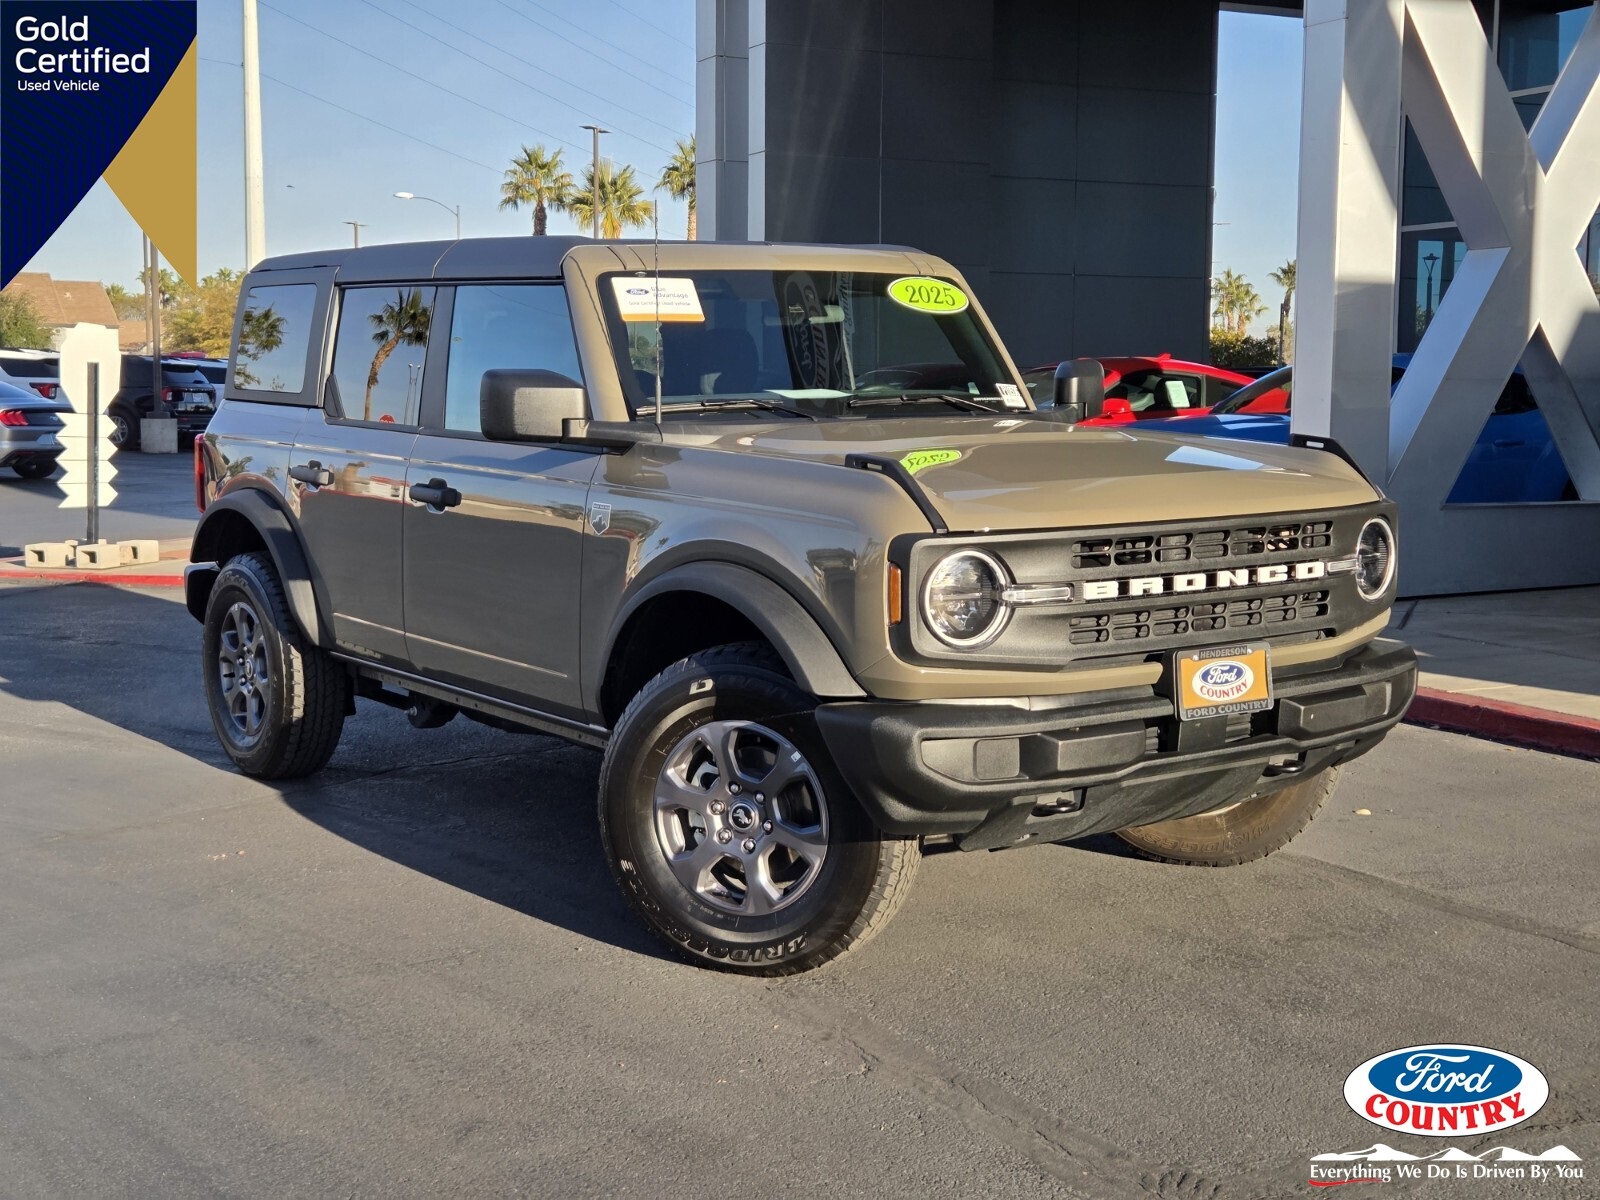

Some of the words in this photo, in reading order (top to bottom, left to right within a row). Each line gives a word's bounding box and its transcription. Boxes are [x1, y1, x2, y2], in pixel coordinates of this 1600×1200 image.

[904, 285, 956, 307] 2025
[1083, 561, 1325, 601] BRONCO
[1200, 646, 1247, 659] HENDERSON
[1207, 664, 1238, 684] Ford
[1199, 679, 1248, 699] COUNTRY
[1187, 706, 1216, 718] FORD
[1218, 700, 1268, 714] COUNTRY
